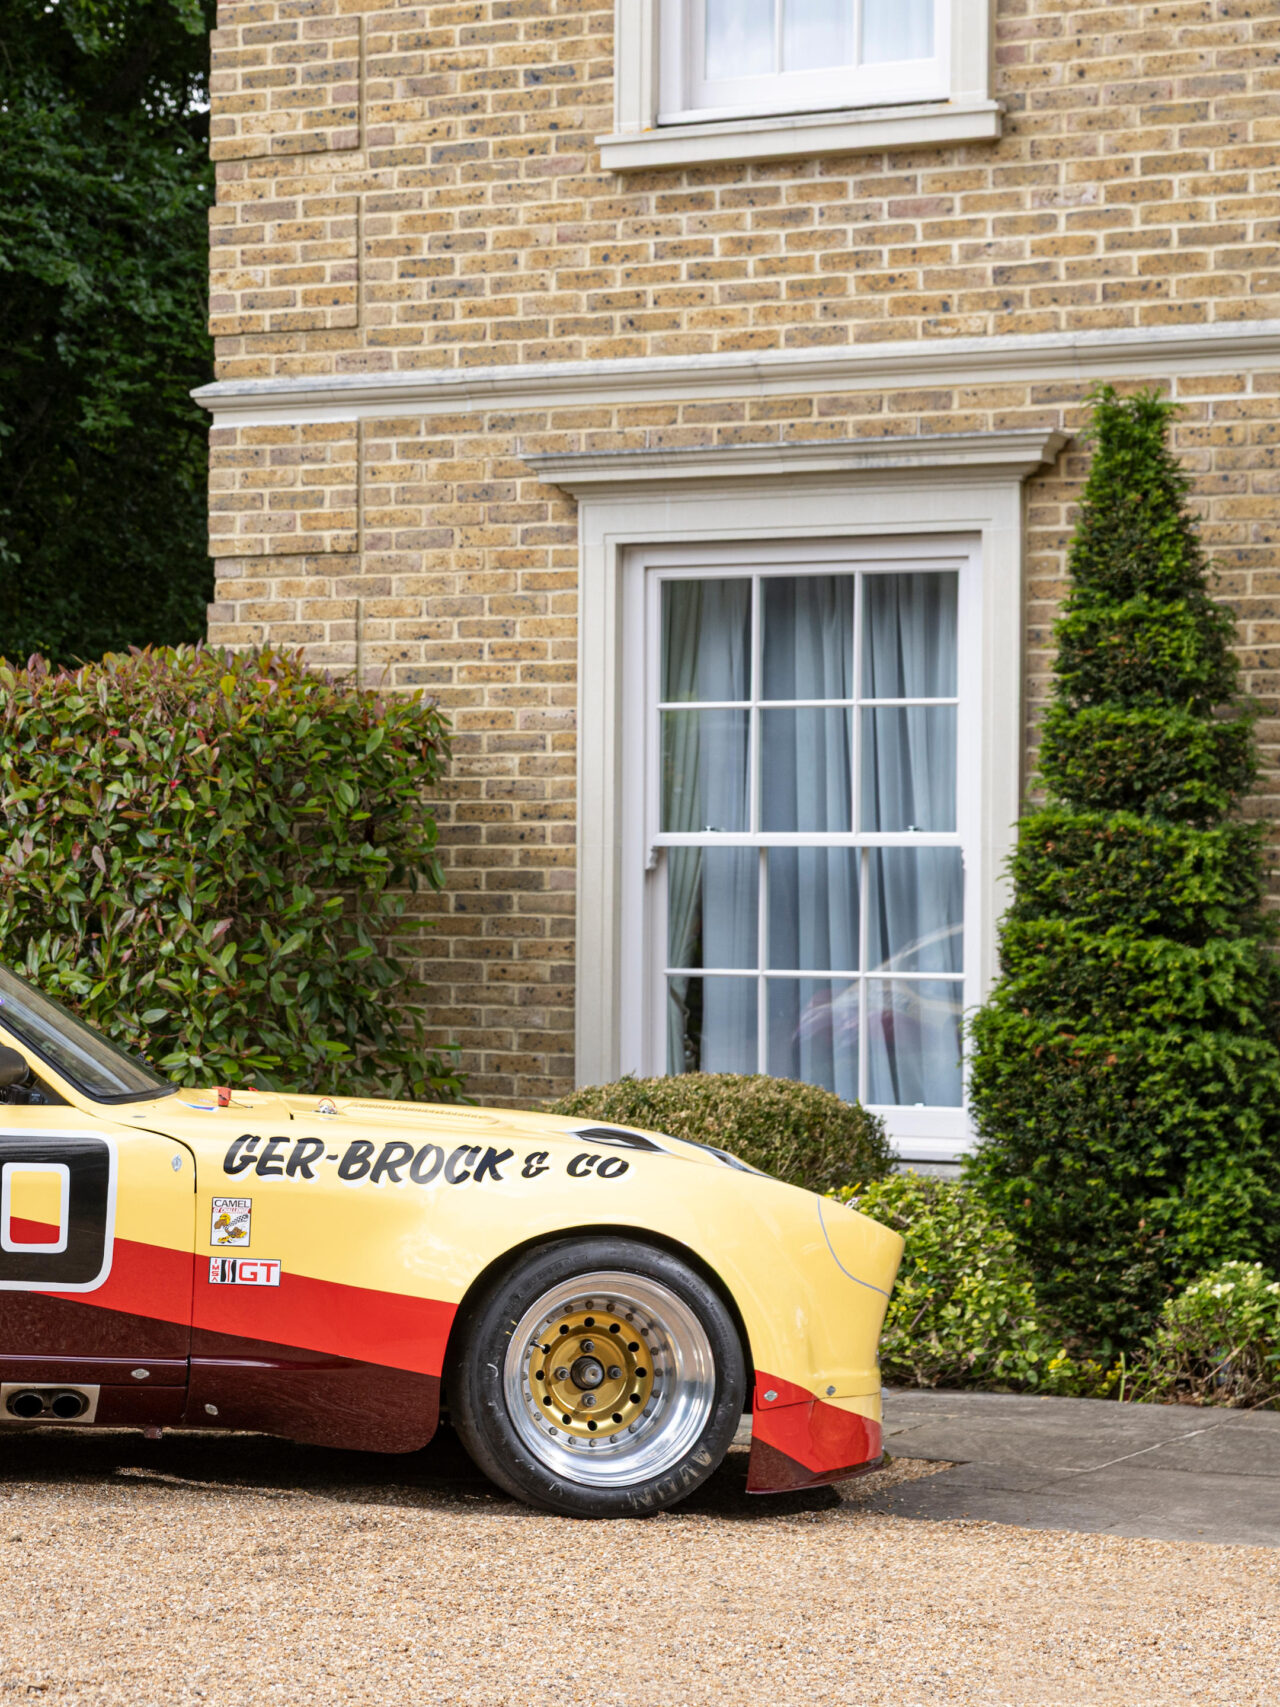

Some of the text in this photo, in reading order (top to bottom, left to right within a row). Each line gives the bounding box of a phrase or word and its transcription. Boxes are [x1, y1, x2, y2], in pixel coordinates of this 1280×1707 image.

[222, 1134, 630, 1186] GER-BROCK & CO
[214, 1199, 250, 1209] CAMEL
[211, 1258, 220, 1282] IMSA
[238, 1262, 279, 1283] GT
